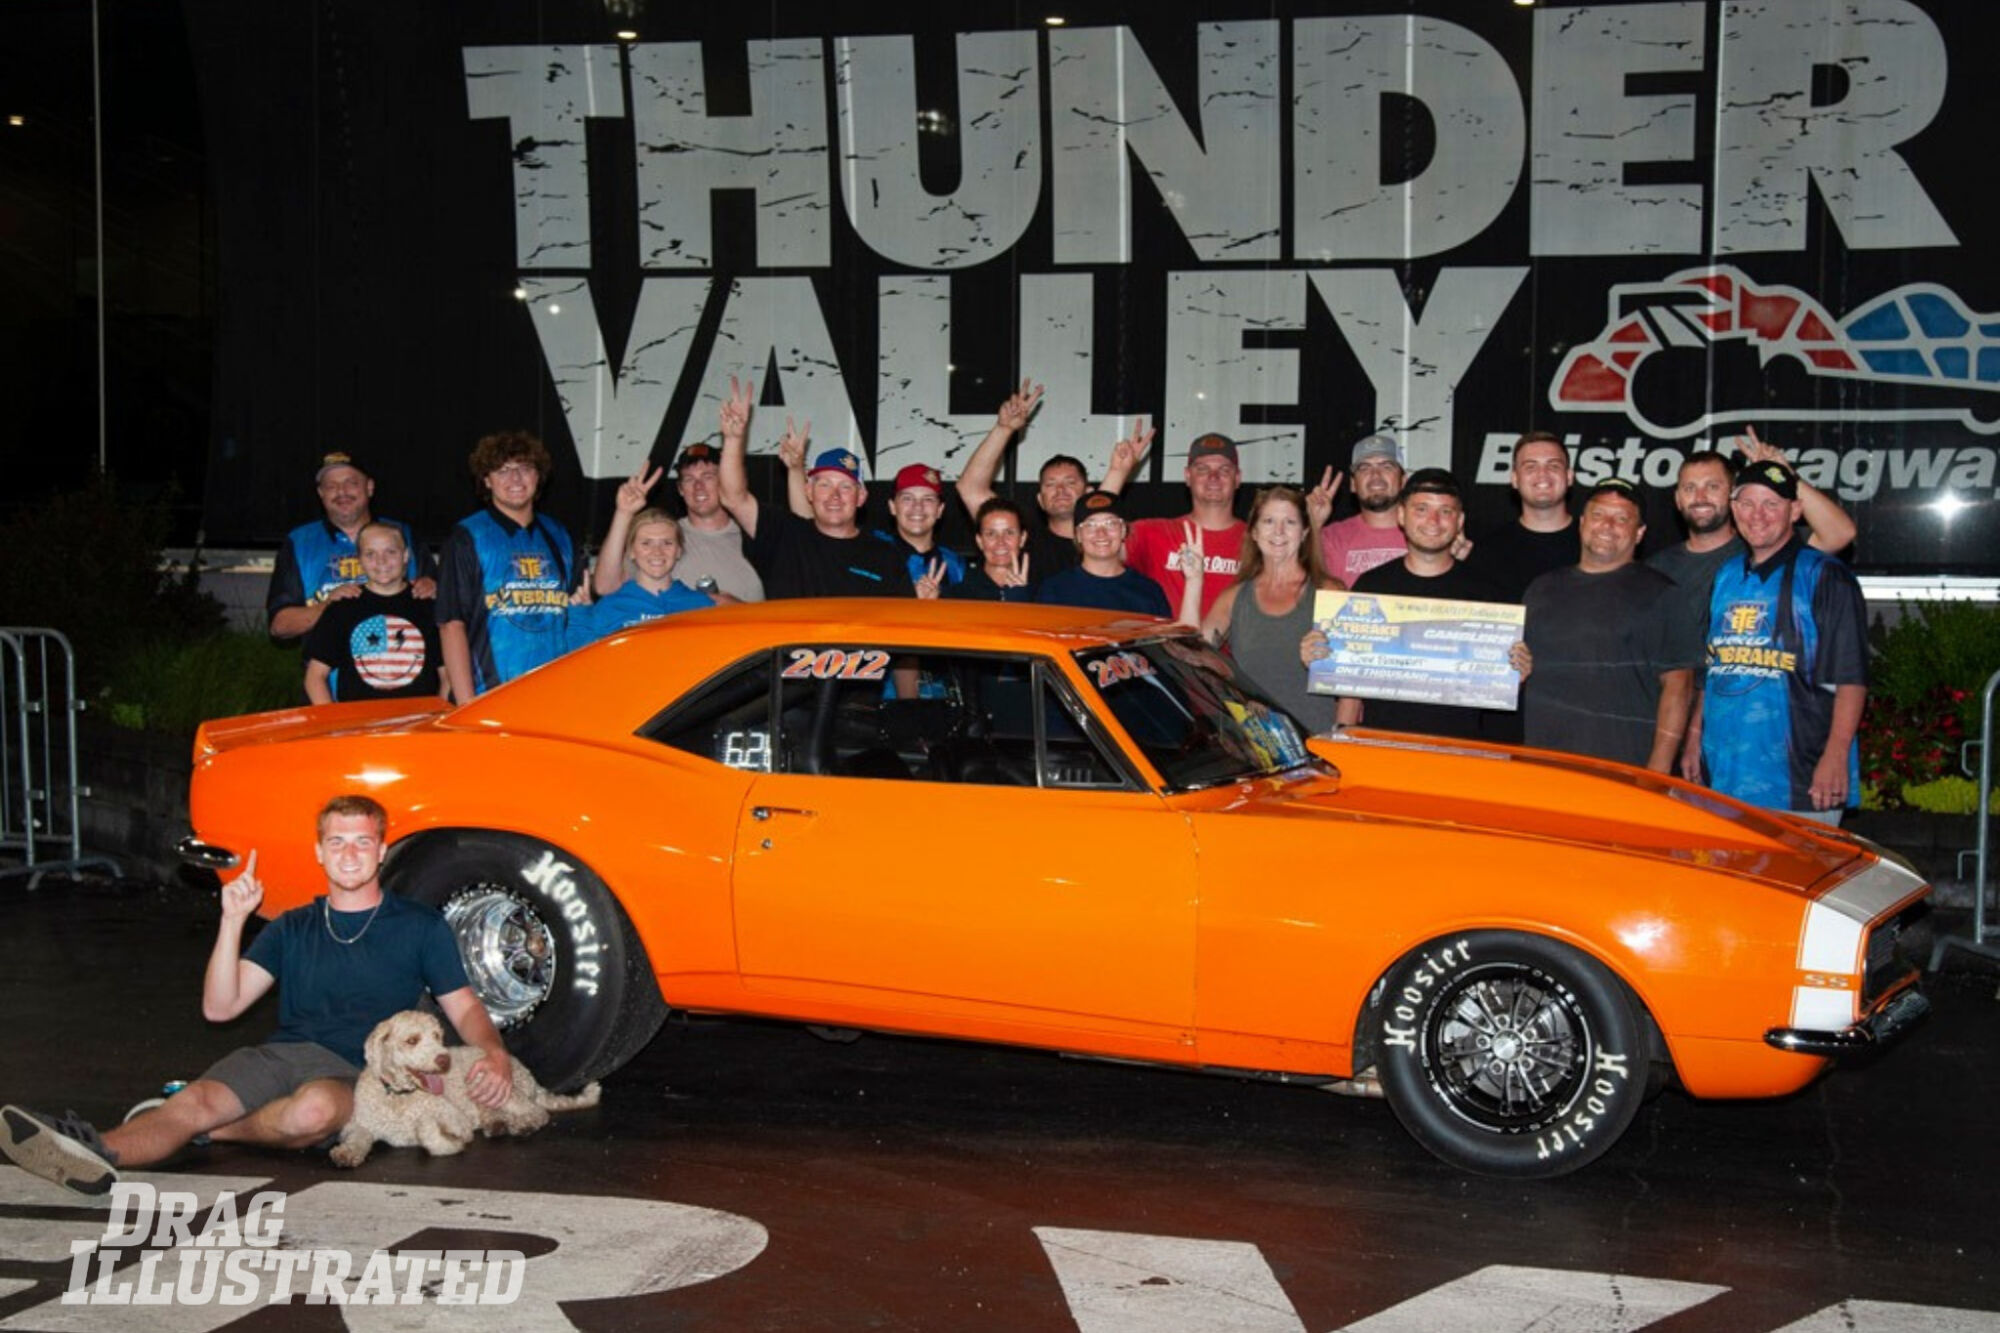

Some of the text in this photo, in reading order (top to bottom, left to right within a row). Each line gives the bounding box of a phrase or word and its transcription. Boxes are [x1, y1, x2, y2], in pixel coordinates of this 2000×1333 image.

[461, 0, 1961, 270] THUNDER
[514, 266, 1531, 484] VALLEY
[1475, 432, 2000, 501] Bisto agwa
[781, 648, 891, 679] 2012
[521, 850, 608, 996] Hoosier
[1384, 939, 1471, 1055] Hoosier
[1537, 1044, 1628, 1160] Hoosier
